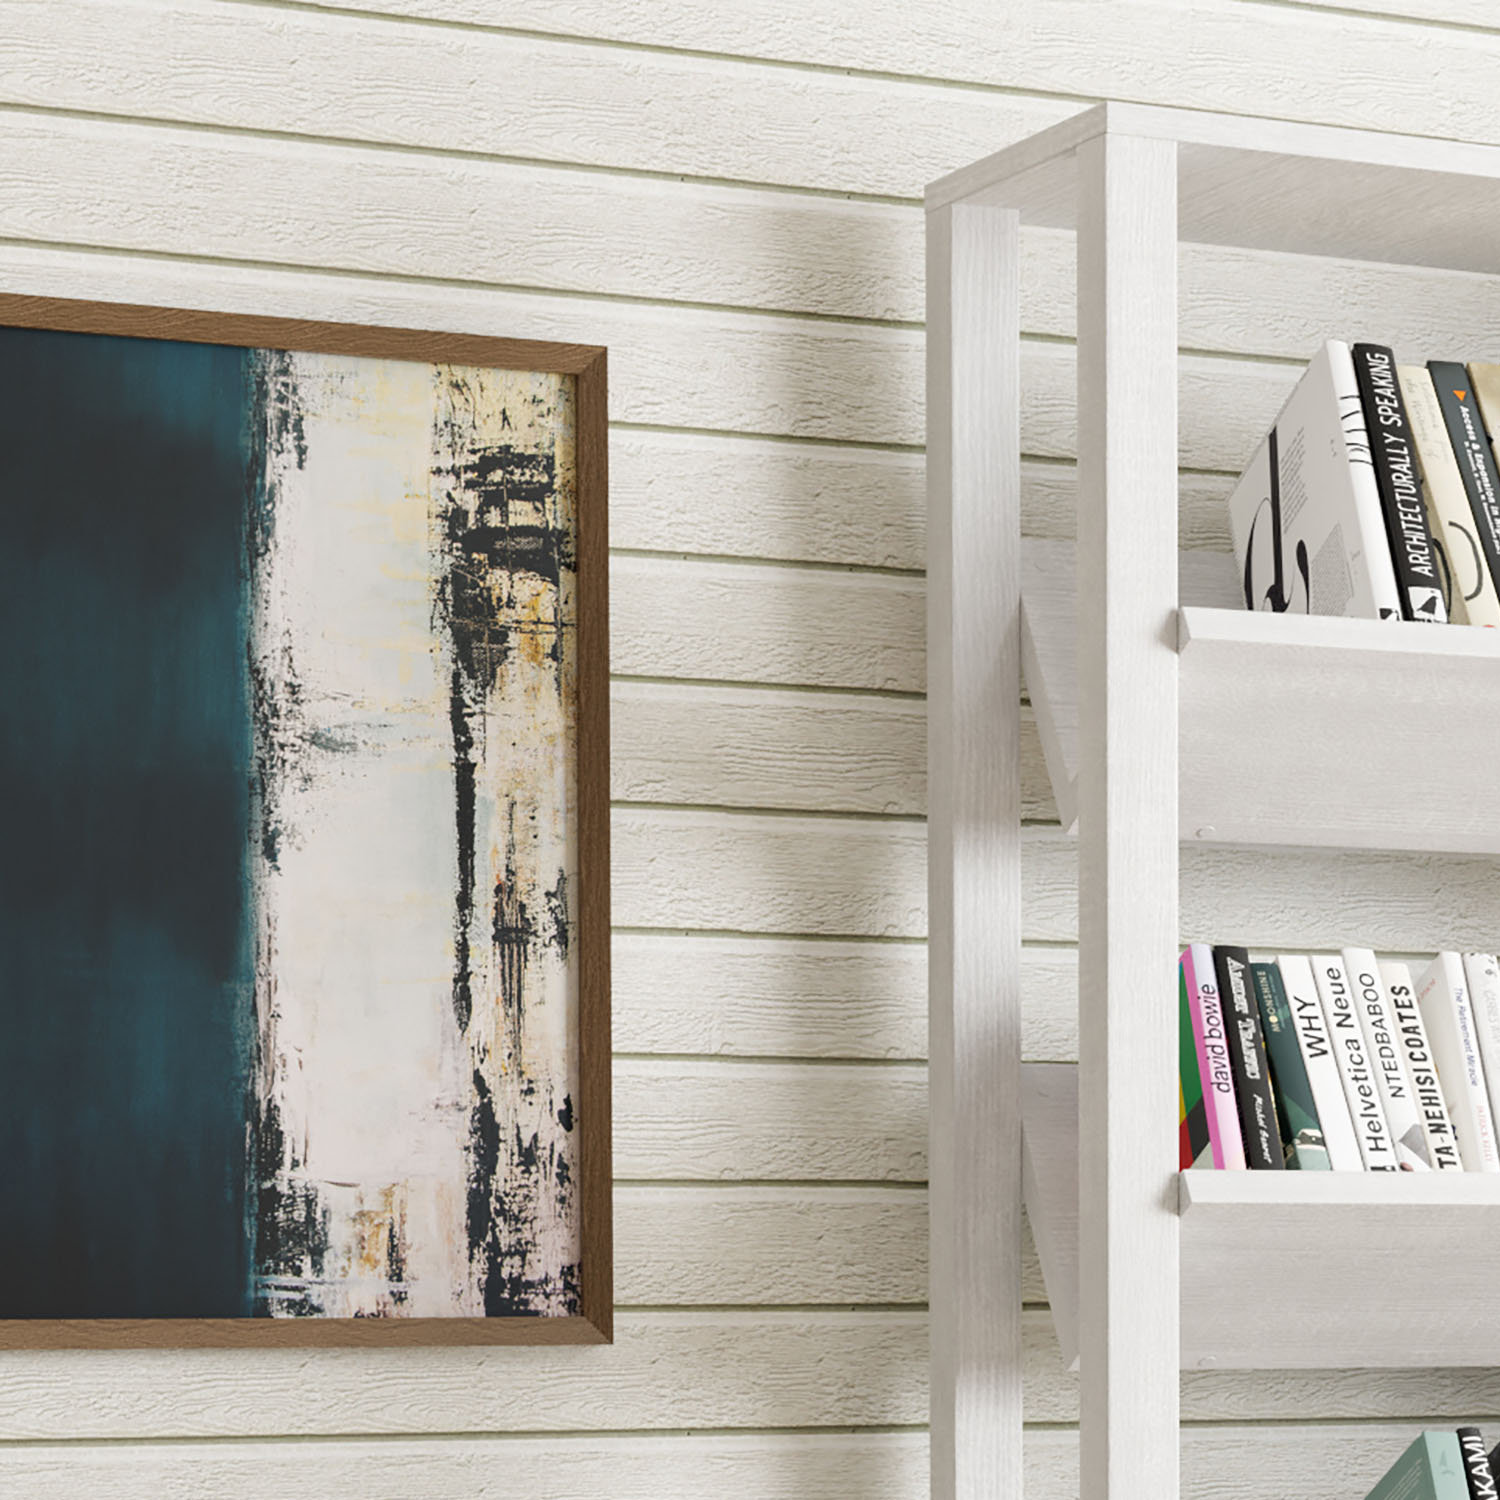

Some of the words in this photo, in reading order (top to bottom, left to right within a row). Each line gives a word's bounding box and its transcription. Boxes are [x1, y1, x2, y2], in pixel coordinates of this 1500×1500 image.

[1365, 352, 1403, 427] SPEAKING
[1459, 405, 1477, 441] Access
[1471, 442, 1481, 451] &
[1382, 432, 1435, 578] ARCHITECTURALLY
[1474, 453, 1496, 503] Expansion
[1490, 505, 1500, 516] in
[1196, 982, 1225, 1041] bowie
[1256, 970, 1281, 1033] MOONSHINE
[1326, 967, 1355, 1029] Neue
[1390, 985, 1428, 1062] COATES
[1455, 988, 1463, 1003] The
[1293, 995, 1329, 1059] WHY
[1358, 973, 1406, 1098] NTEDBABOO
[1458, 1005, 1473, 1053] Retirement
[1205, 1043, 1231, 1093] david
[1344, 1038, 1388, 1152] Helvetica
[1466, 1054, 1478, 1087] Miracle
[1412, 1068, 1457, 1170] TA-NEHISI
